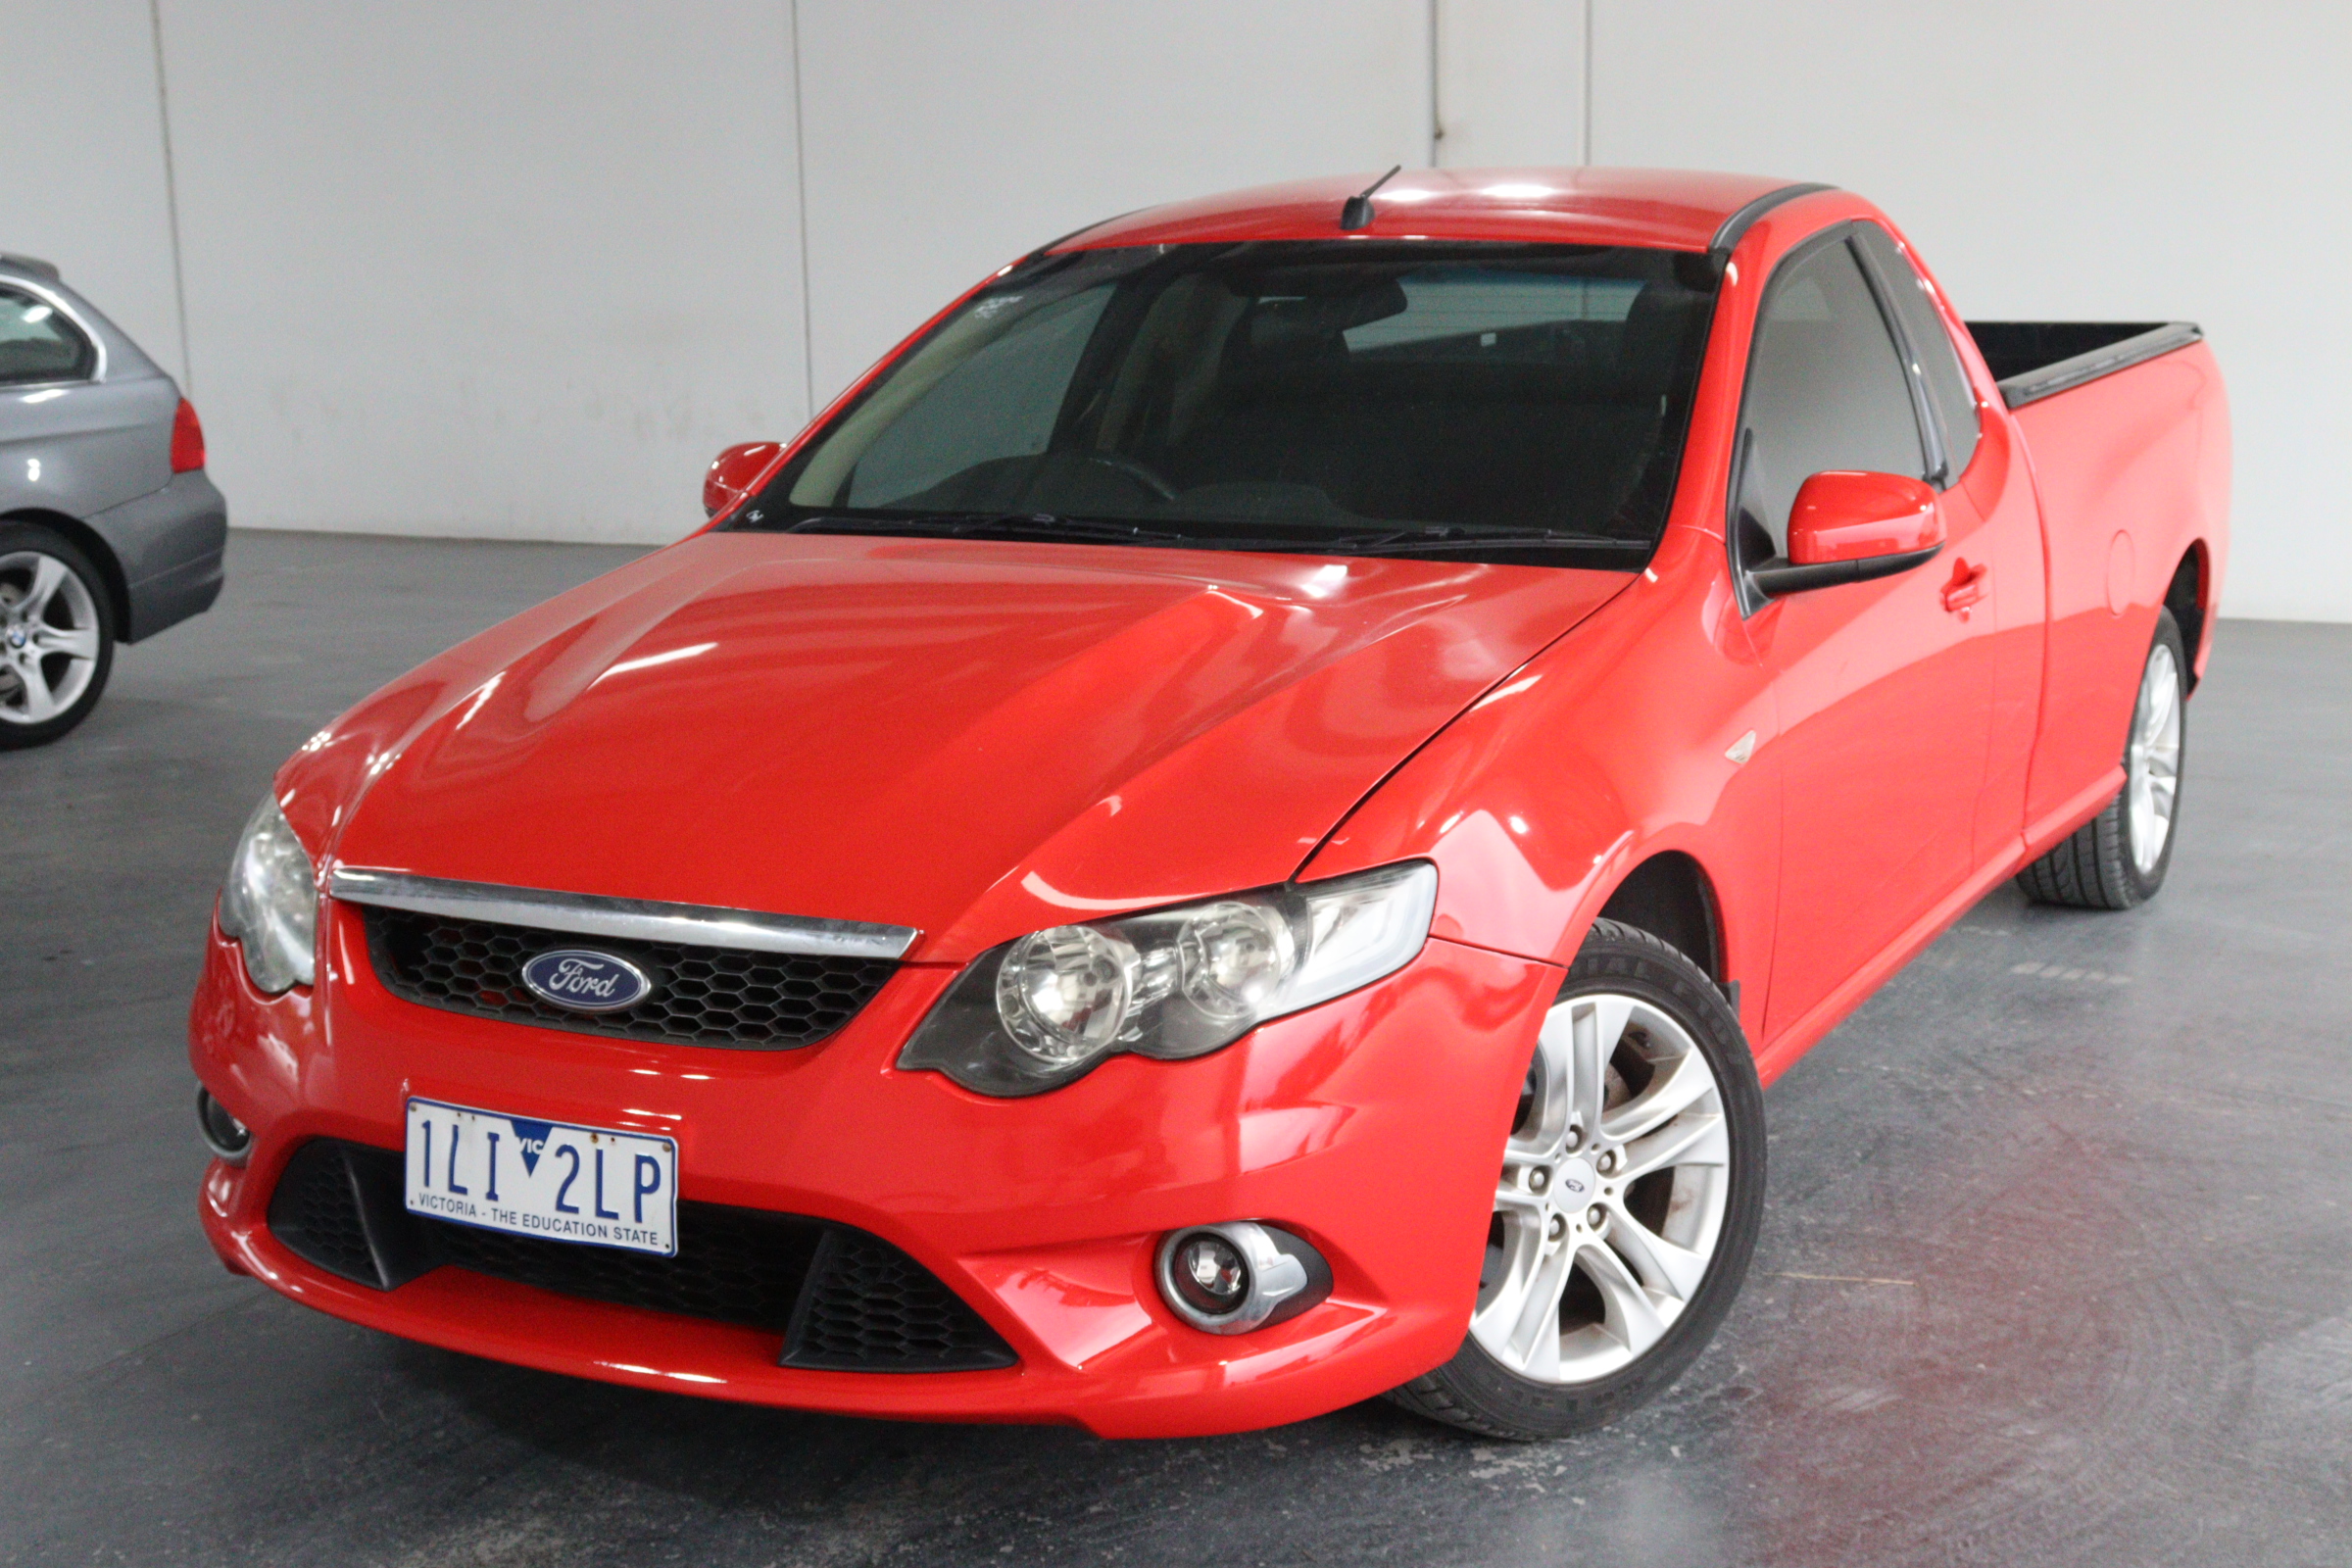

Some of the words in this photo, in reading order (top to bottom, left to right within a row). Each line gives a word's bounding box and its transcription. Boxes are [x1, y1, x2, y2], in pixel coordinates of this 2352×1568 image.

[549, 958, 619, 998] Ford
[515, 1136, 544, 1154] VIC
[421, 1119, 500, 1202] 1LI
[555, 1144, 662, 1223] 2LP
[418, 1193, 476, 1217] VICTORIA
[491, 1207, 517, 1225] THE
[522, 1213, 608, 1239] EDUCATION
[613, 1227, 659, 1246] STATE
